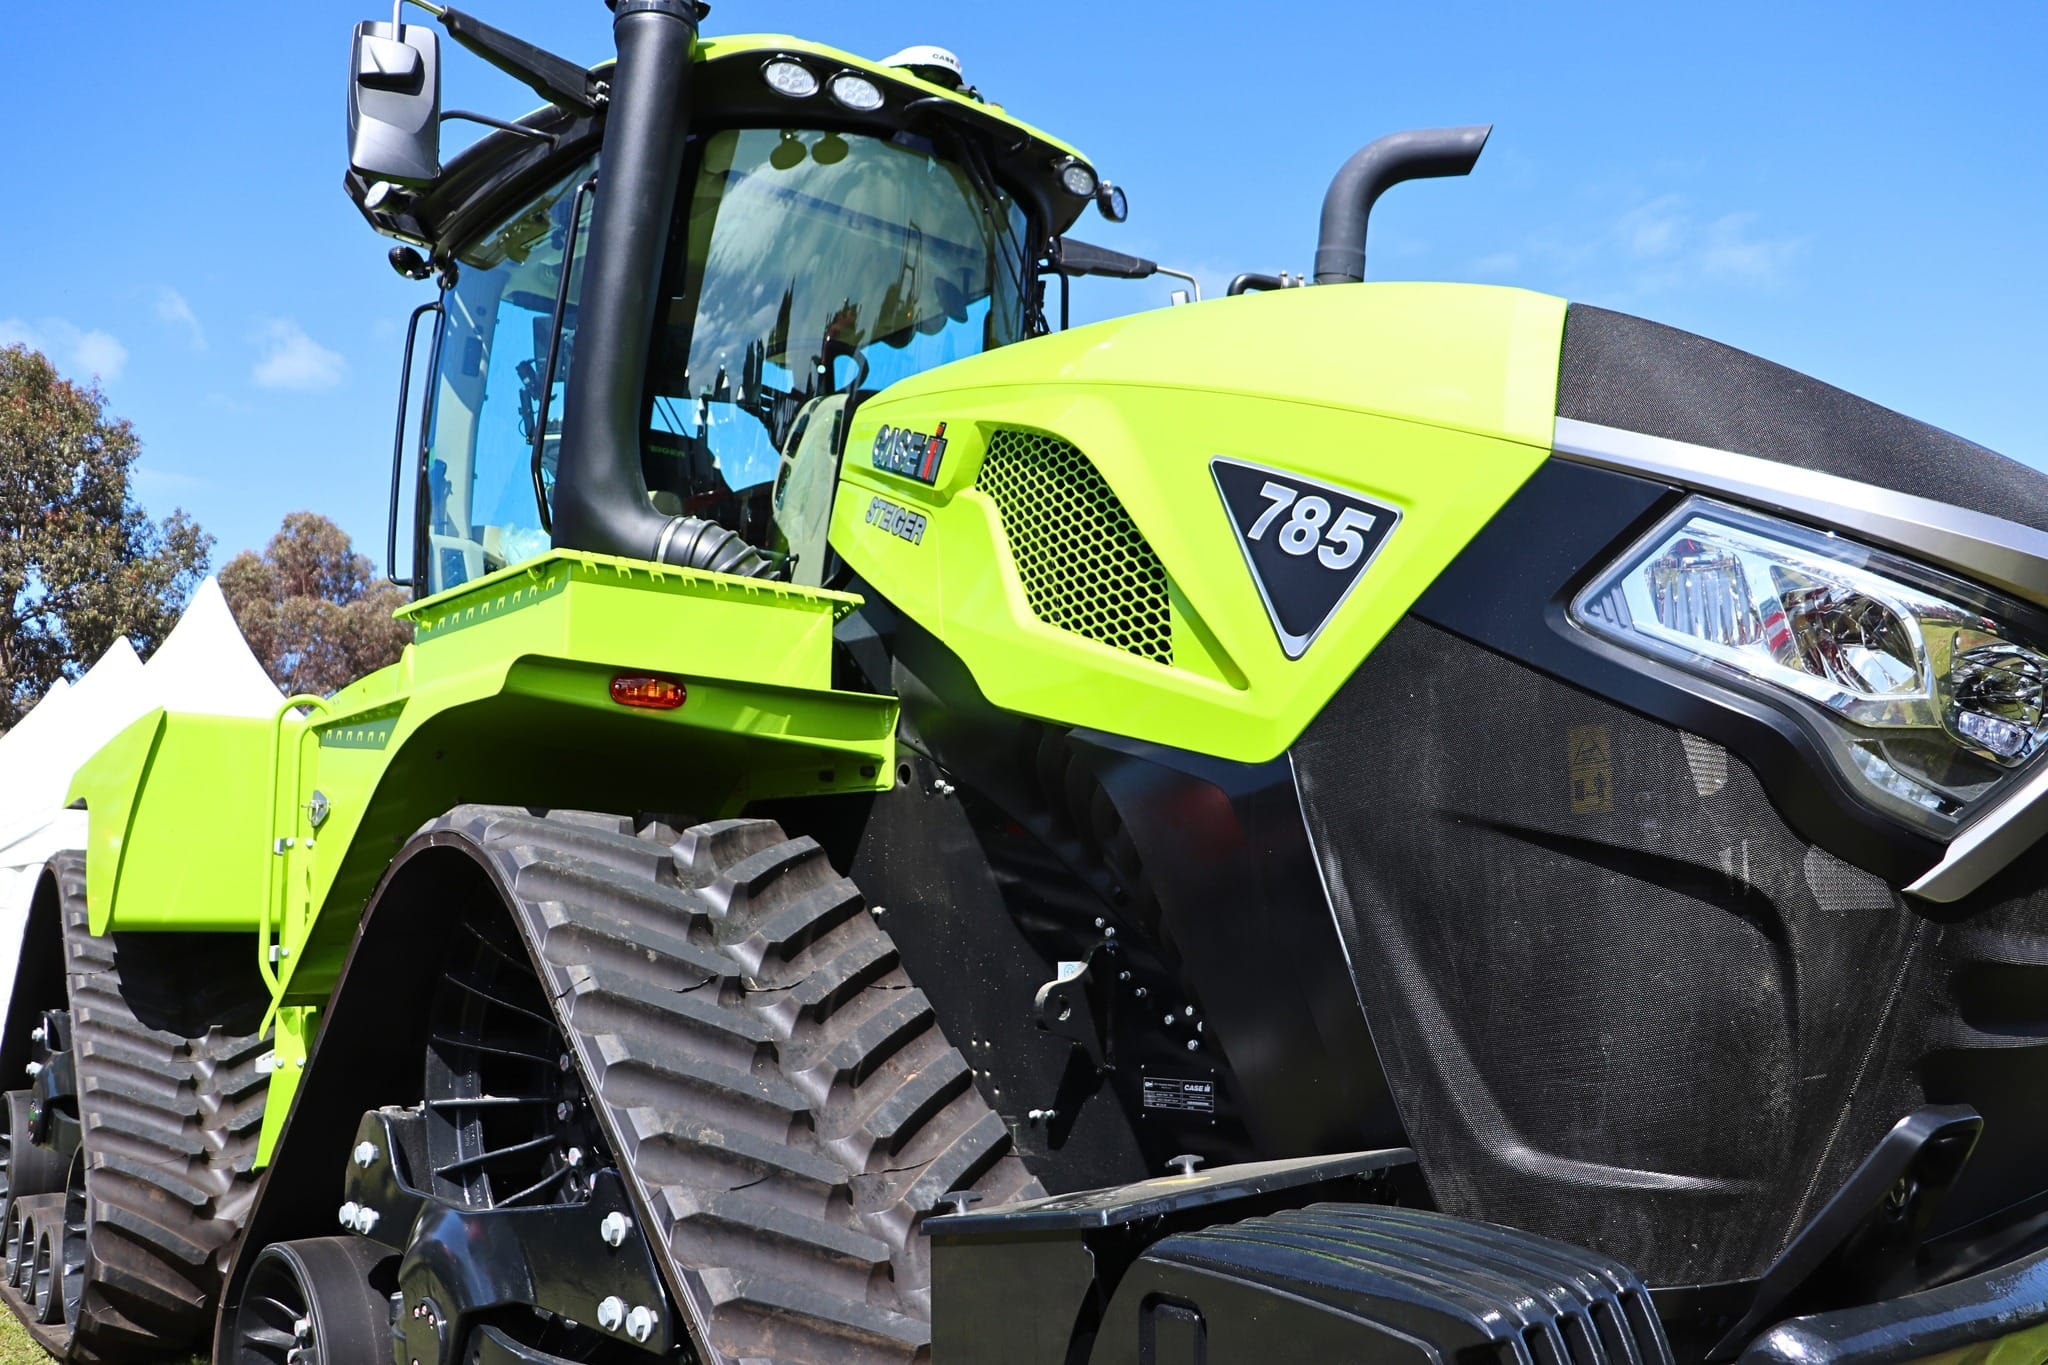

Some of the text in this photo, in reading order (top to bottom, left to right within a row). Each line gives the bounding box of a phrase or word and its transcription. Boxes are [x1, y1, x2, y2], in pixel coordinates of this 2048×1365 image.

[873, 424, 927, 475] CASE
[866, 496, 928, 546] STEIGER
[1247, 481, 1377, 570] 785
[1184, 1084, 1204, 1093] CASE
